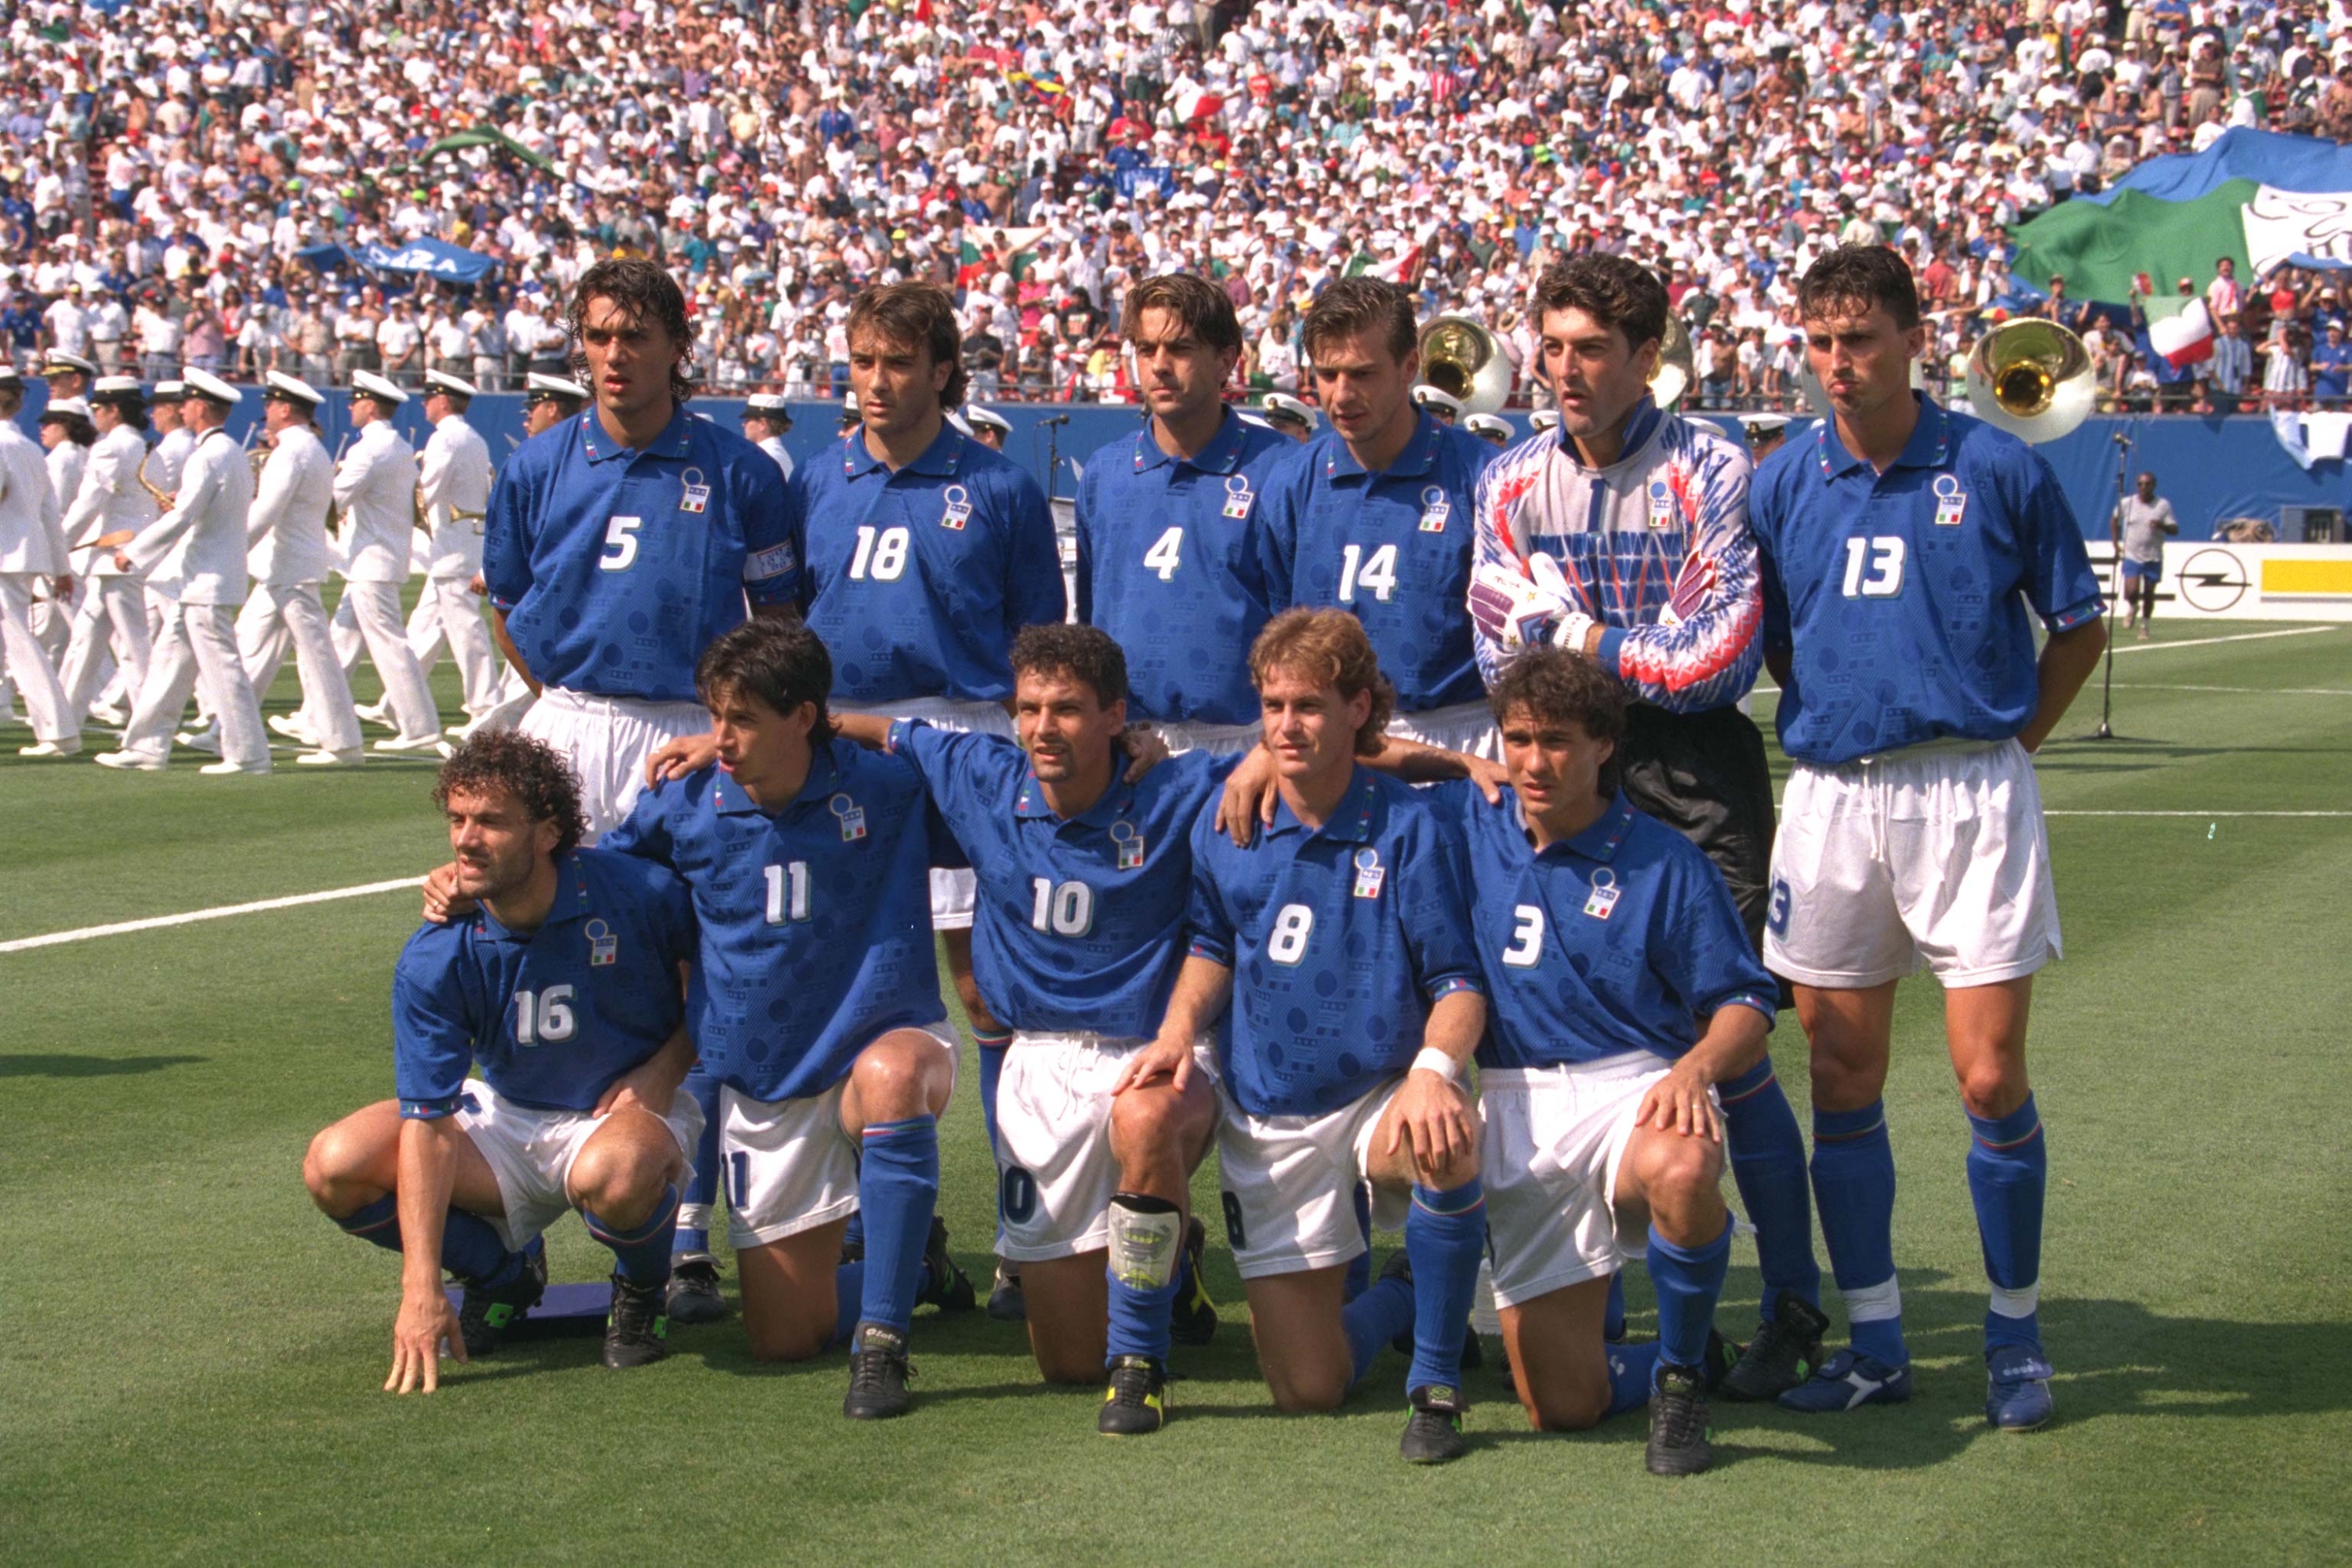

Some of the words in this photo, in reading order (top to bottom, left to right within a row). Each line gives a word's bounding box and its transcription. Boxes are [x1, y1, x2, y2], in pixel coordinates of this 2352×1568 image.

[599, 515, 641, 572] 5
[849, 524, 910, 583] 18
[1143, 525, 1185, 583] 4
[1338, 543, 1399, 604] 14
[1841, 535, 1907, 598] 13
[764, 861, 810, 925] 11
[1031, 877, 1093, 936] 10
[1766, 872, 1792, 942] 3
[1267, 903, 1315, 966] 8
[1501, 903, 1546, 968] 3
[514, 985, 577, 1045] 16
